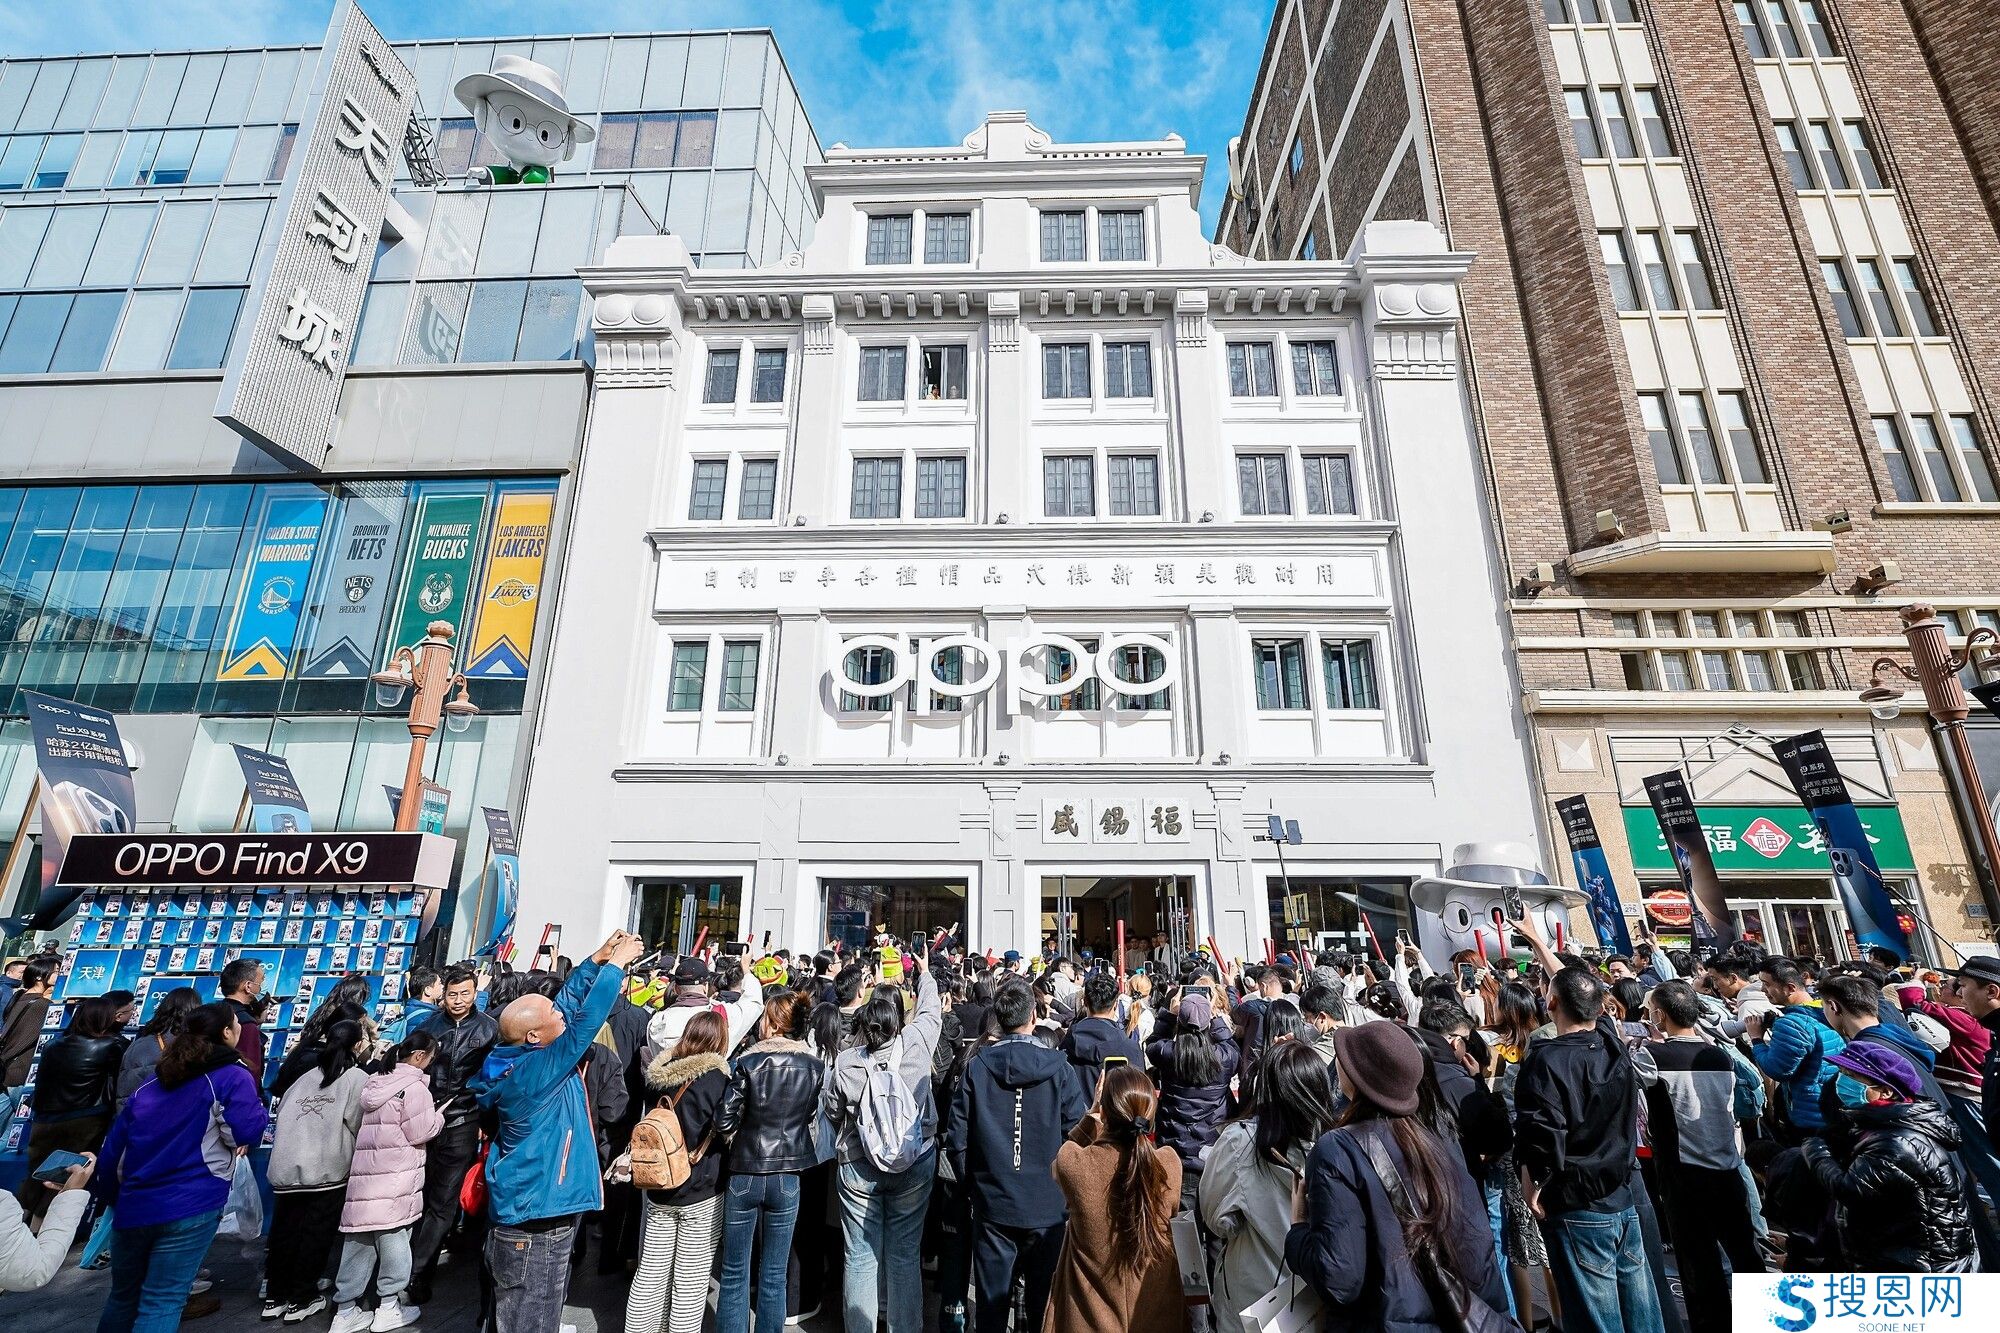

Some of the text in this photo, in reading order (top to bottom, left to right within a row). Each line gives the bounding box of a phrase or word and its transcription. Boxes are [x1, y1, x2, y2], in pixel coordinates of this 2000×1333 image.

[277, 100, 390, 375] 天河城
[265, 526, 319, 540] GOLDEN STATE
[352, 525, 390, 537] BROOKLYN
[426, 524, 472, 537] MILWAUKEE
[499, 526, 546, 537] LOS ANGELES
[259, 544, 315, 562] WARRIORS
[347, 538, 387, 560] NETS
[421, 539, 469, 560] BUCKS
[495, 539, 545, 558] LAKERS
[345, 576, 373, 589] NETS
[490, 585, 534, 600] LAKERS
[829, 634, 1177, 717] oppo
[55, 723, 76, 733] Find
[114, 841, 370, 876] OPPO Find X9
[78, 965, 105, 980] 天津
